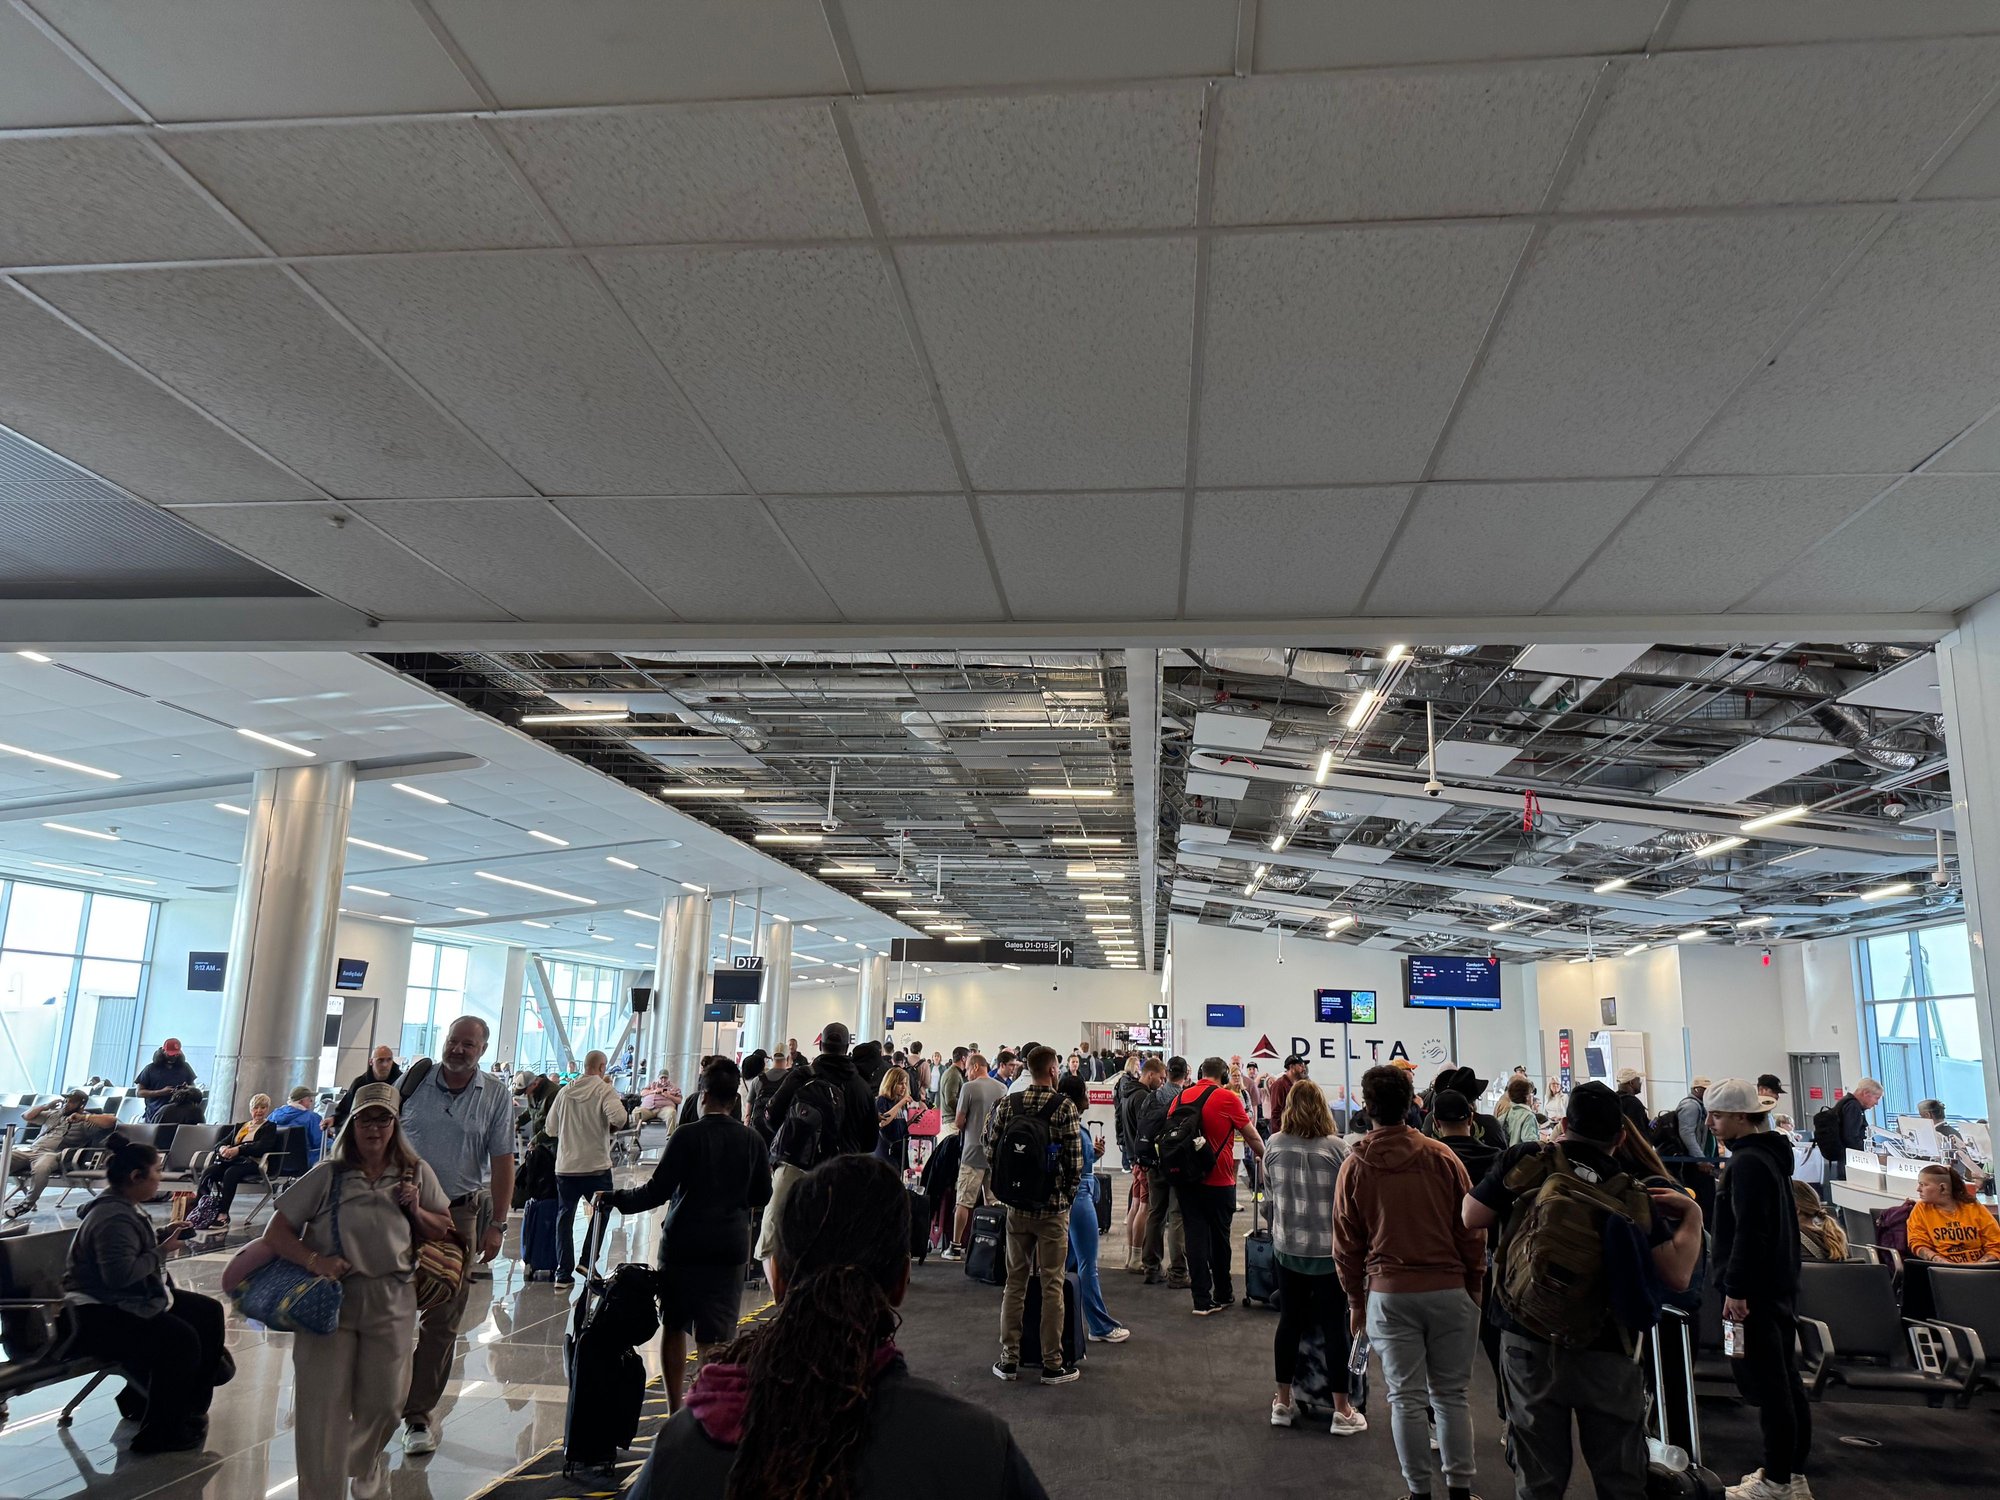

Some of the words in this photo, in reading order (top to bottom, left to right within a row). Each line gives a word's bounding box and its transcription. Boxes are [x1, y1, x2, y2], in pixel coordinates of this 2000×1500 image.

[1004, 941, 1024, 949] Gates
[736, 956, 760, 969] D17
[1291, 1037, 1410, 1062] DELTA
[1904, 1164, 1921, 1173] DELT
[1933, 1226, 1978, 1241] SPOOKY
